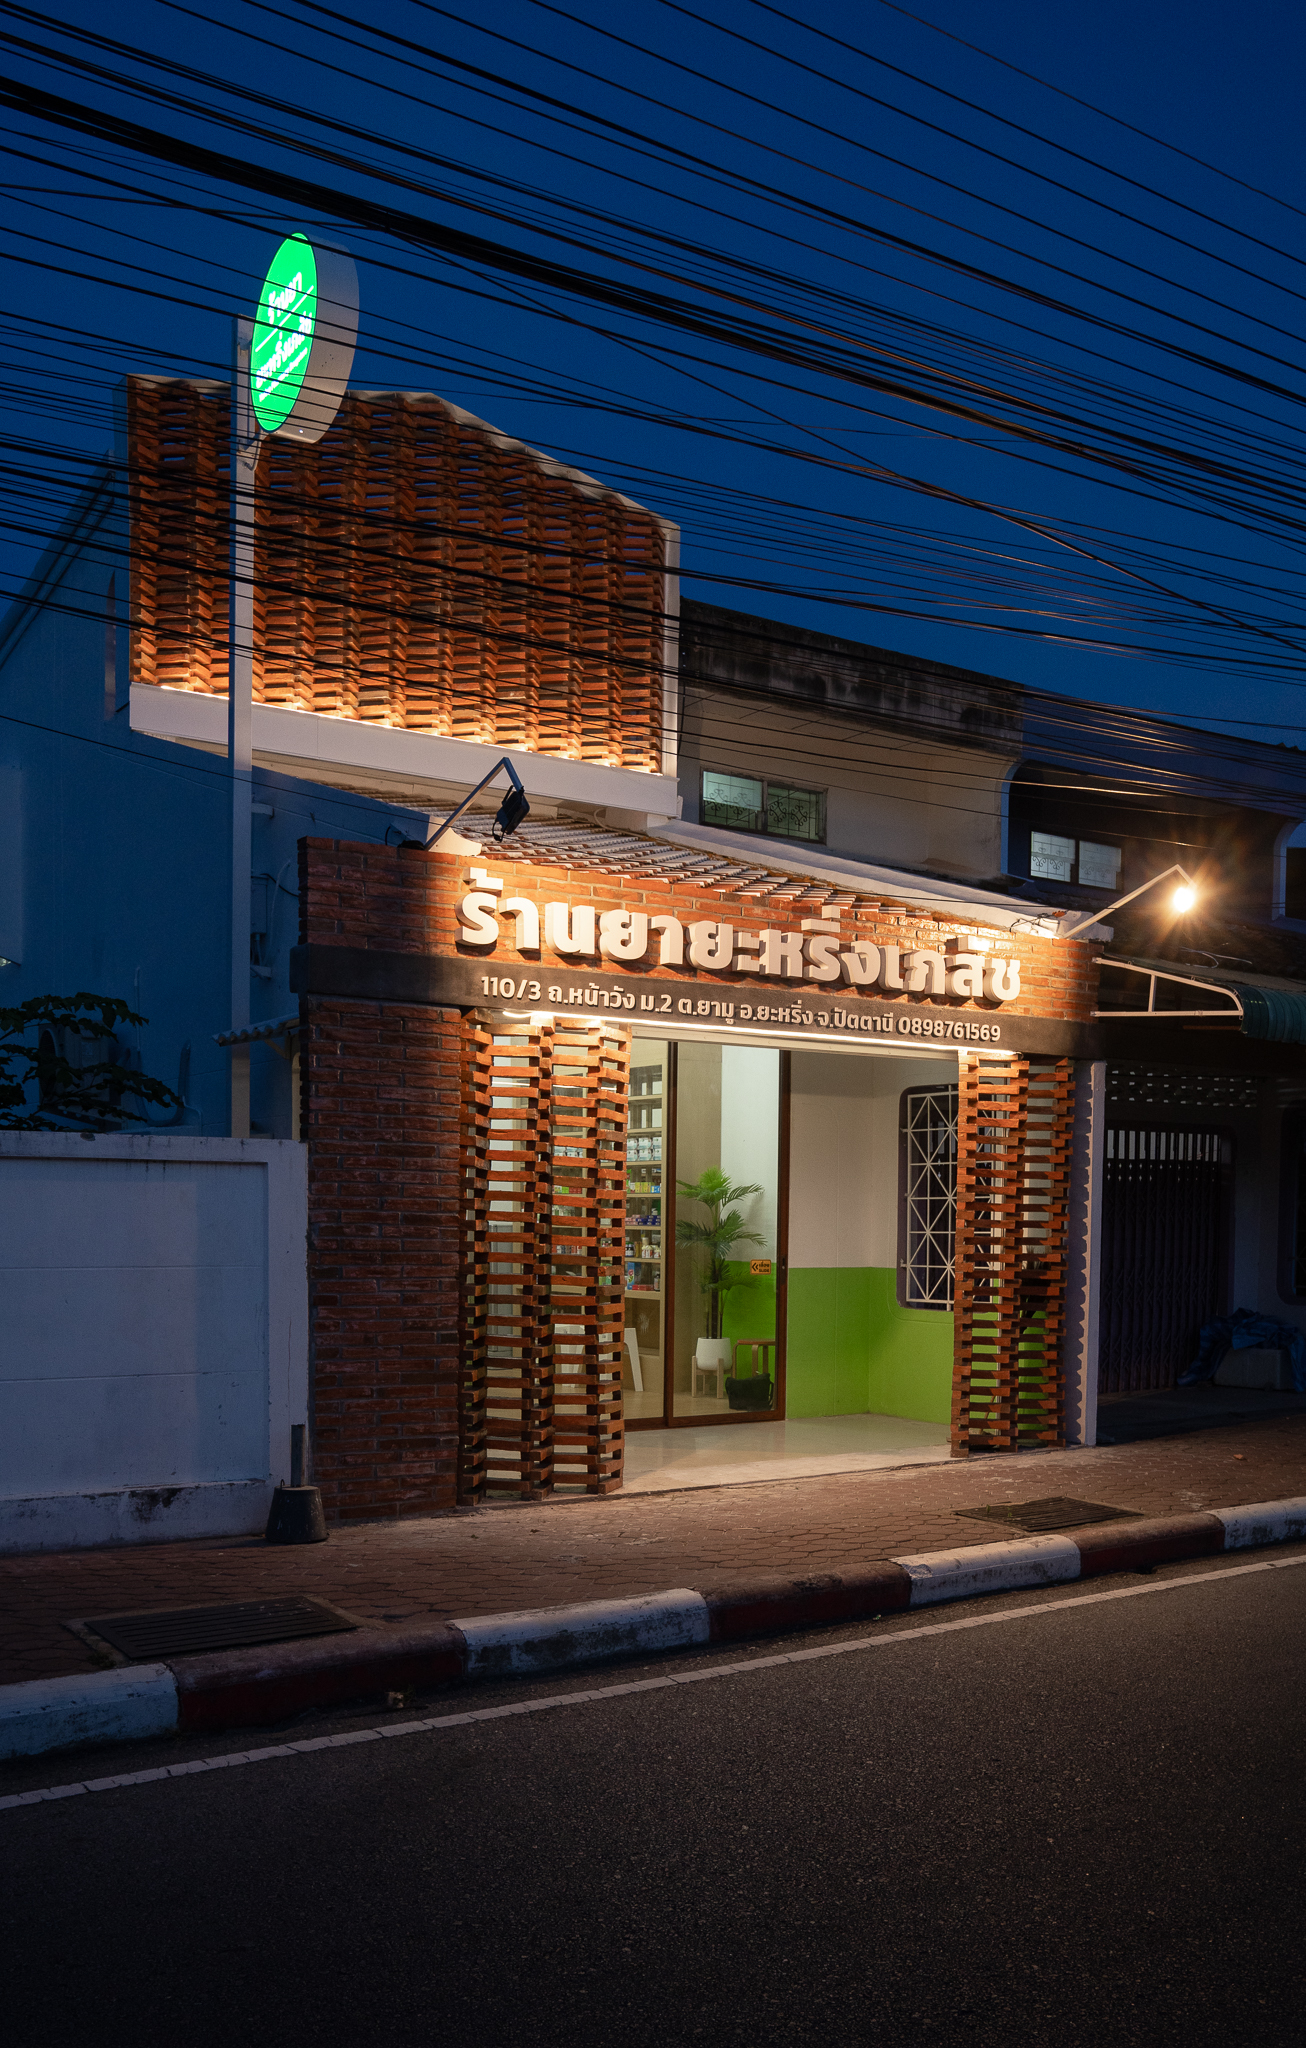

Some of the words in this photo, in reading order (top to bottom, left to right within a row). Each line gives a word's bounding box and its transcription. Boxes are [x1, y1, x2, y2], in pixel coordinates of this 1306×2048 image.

[481, 975, 541, 1001] 110/3
[548, 982, 636, 1010] ถ.หน้าวัง
[640, 994, 672, 1013] ม.2
[677, 998, 735, 1025] ต.ยามู
[740, 999, 813, 1025] อ.ยะหริ่ง
[817, 1007, 894, 1033] จ.ปัตตานี
[898, 1016, 1002, 1043] 0898761569
